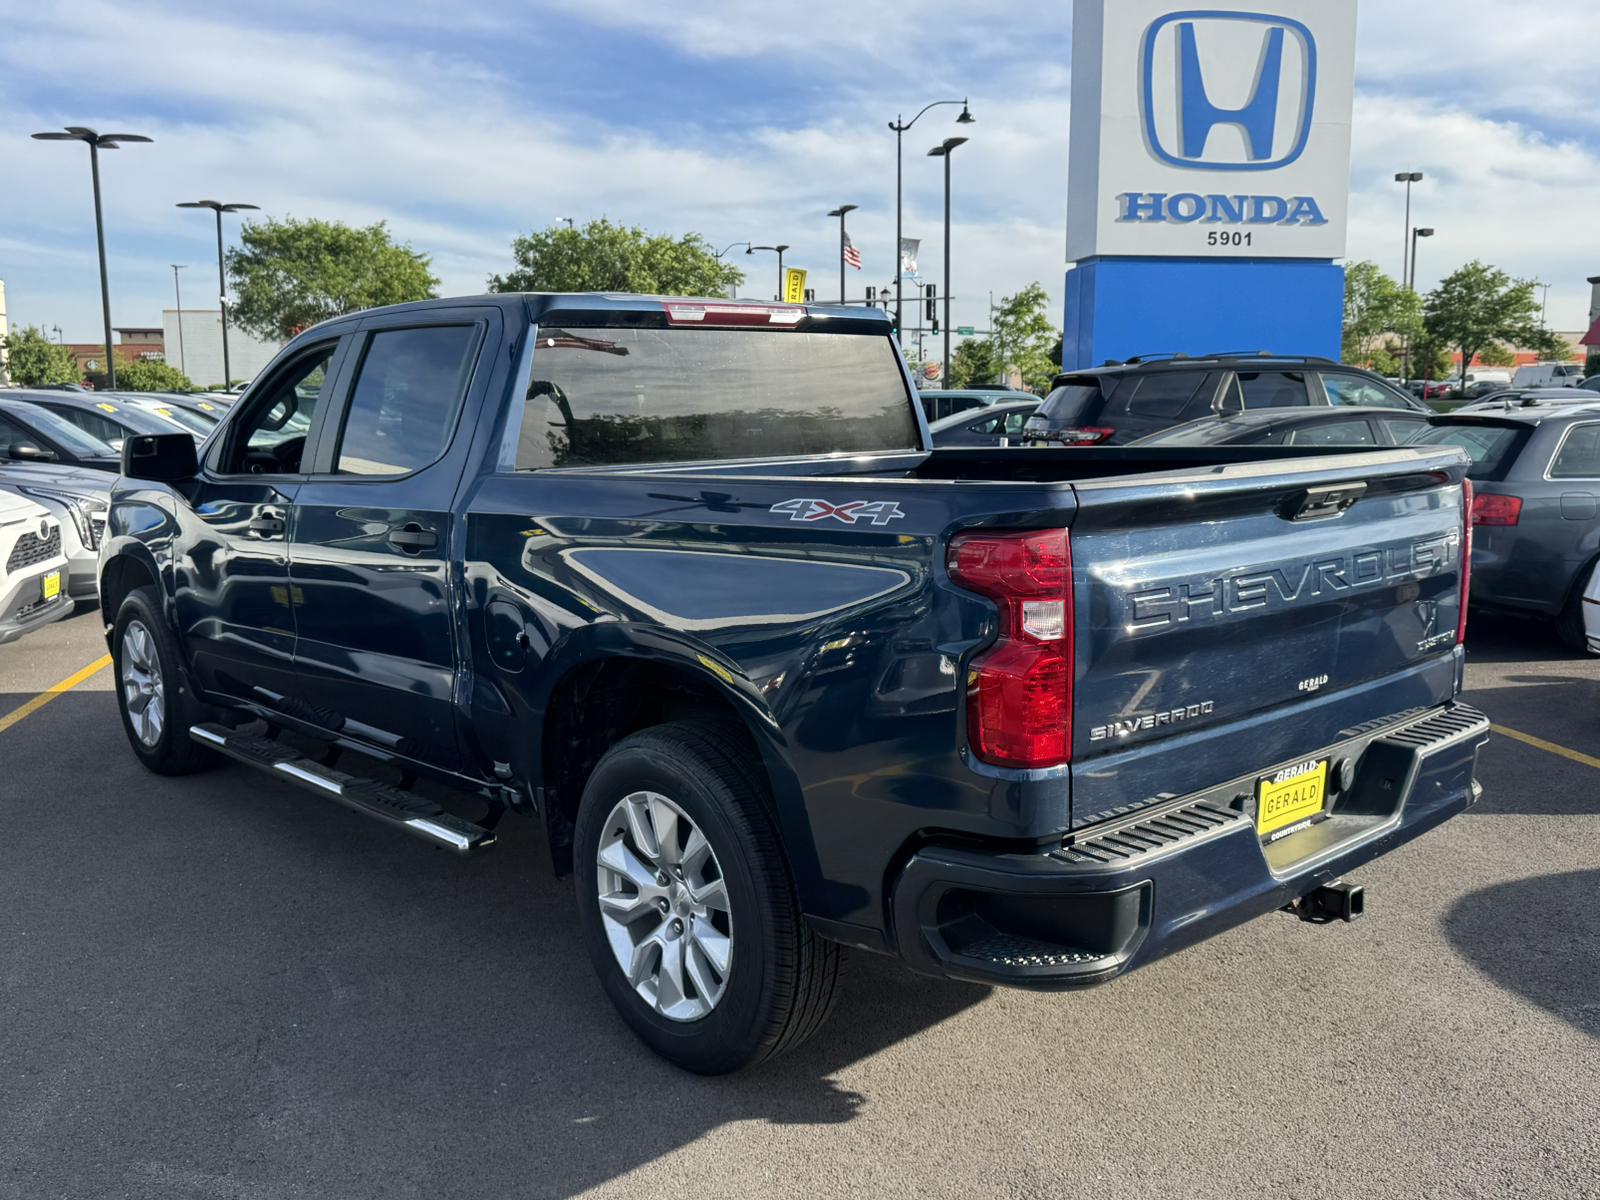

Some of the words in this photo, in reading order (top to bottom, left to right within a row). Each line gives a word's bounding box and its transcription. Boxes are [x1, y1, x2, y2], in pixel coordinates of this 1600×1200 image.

[1115, 192, 1329, 226] HONDA
[1207, 231, 1252, 247] 5901
[1124, 532, 1458, 632] CHEVROLET
[1298, 673, 1329, 691] GERALD
[1089, 700, 1215, 741] SILVERADO
[1274, 759, 1320, 784] GERALD
[1267, 784, 1317, 814] GERALD
